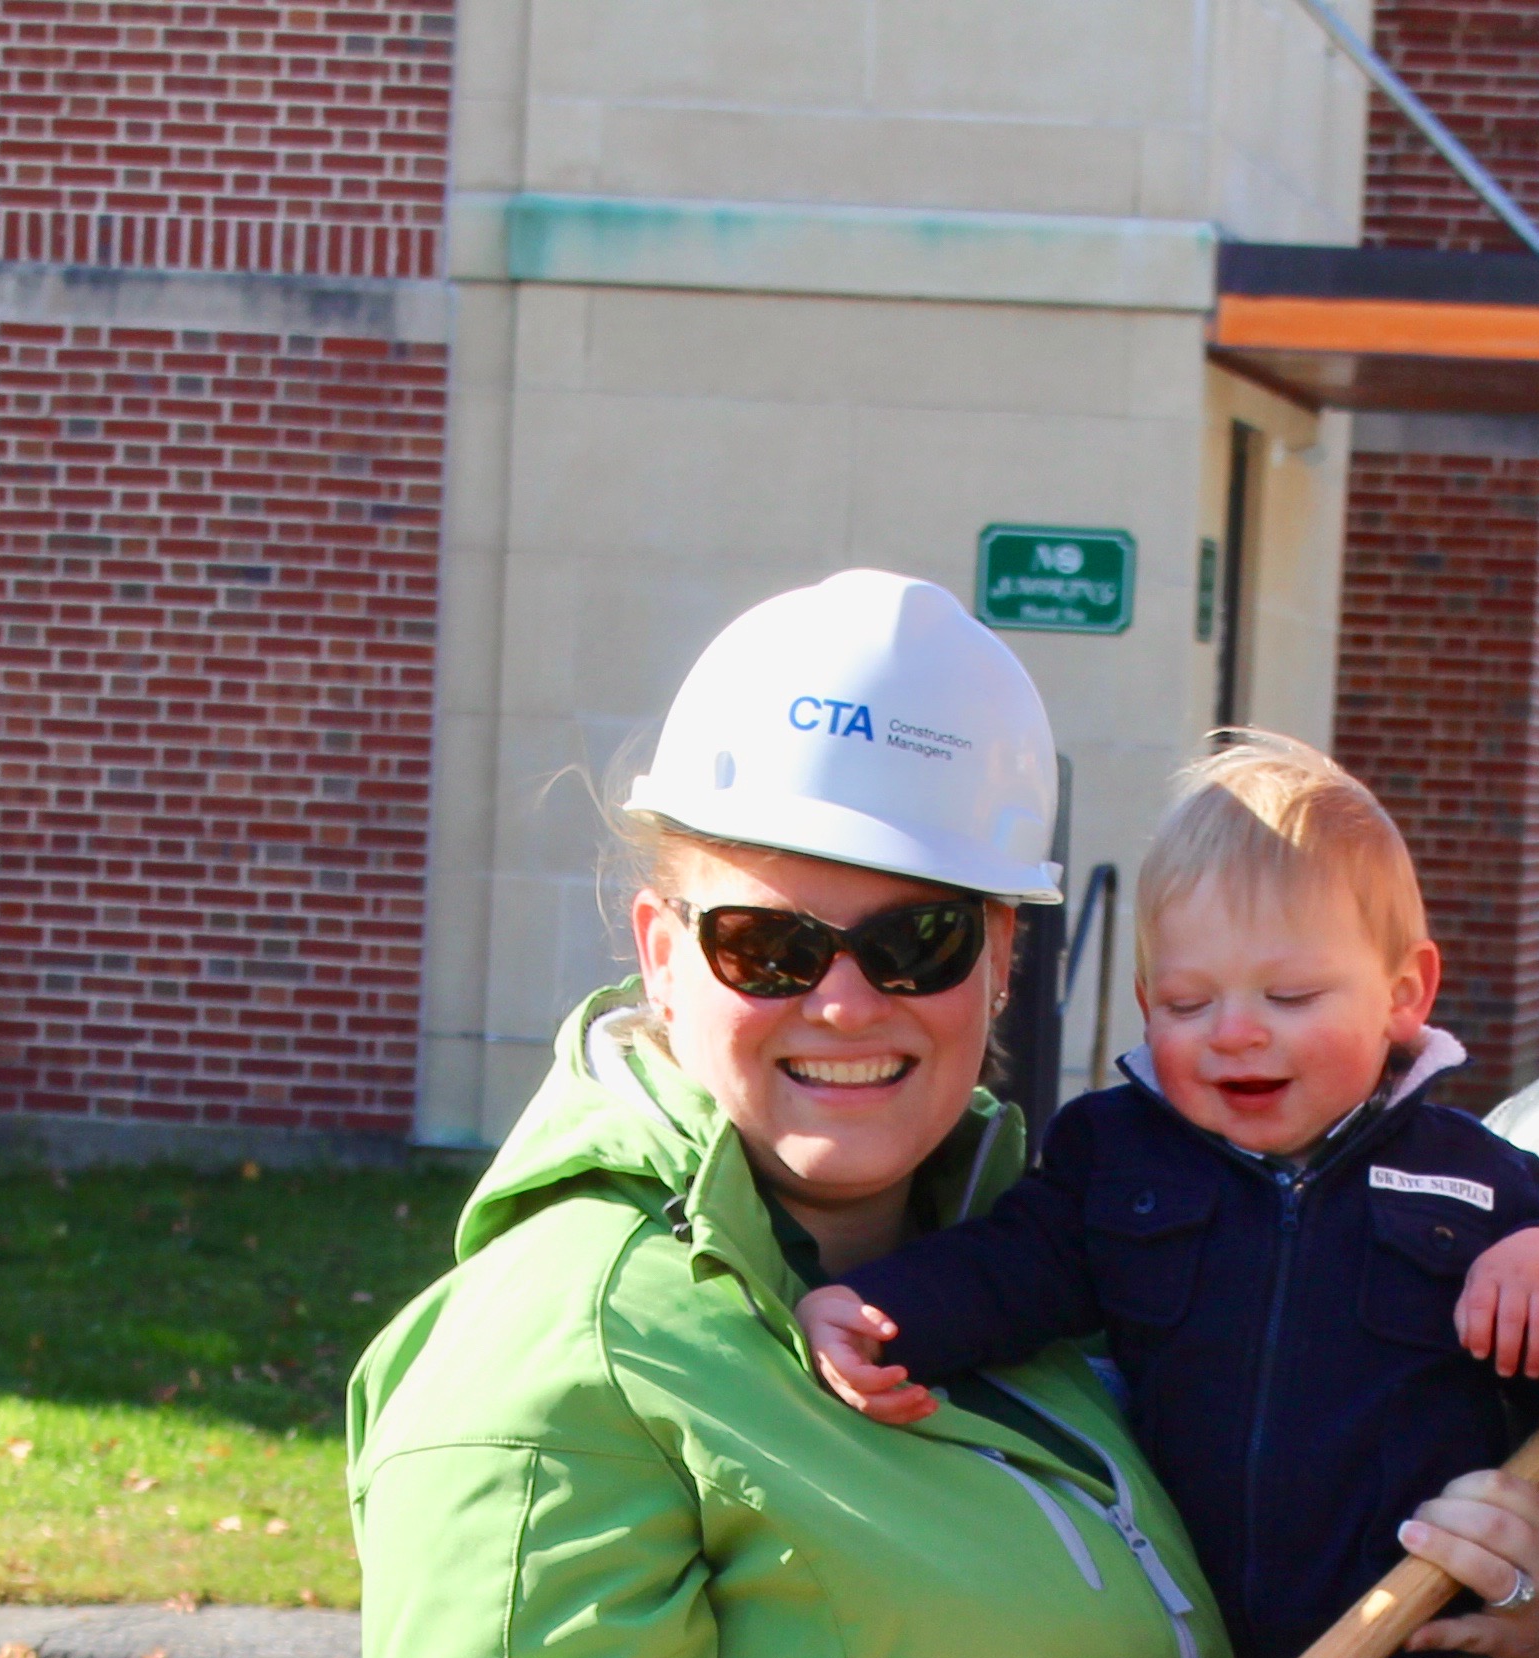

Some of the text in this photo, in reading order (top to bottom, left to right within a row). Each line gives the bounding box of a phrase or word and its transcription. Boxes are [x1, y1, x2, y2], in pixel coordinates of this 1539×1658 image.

[788, 696, 874, 741] CTA
[886, 734, 953, 760] Managers
[889, 719, 972, 750] Construction
